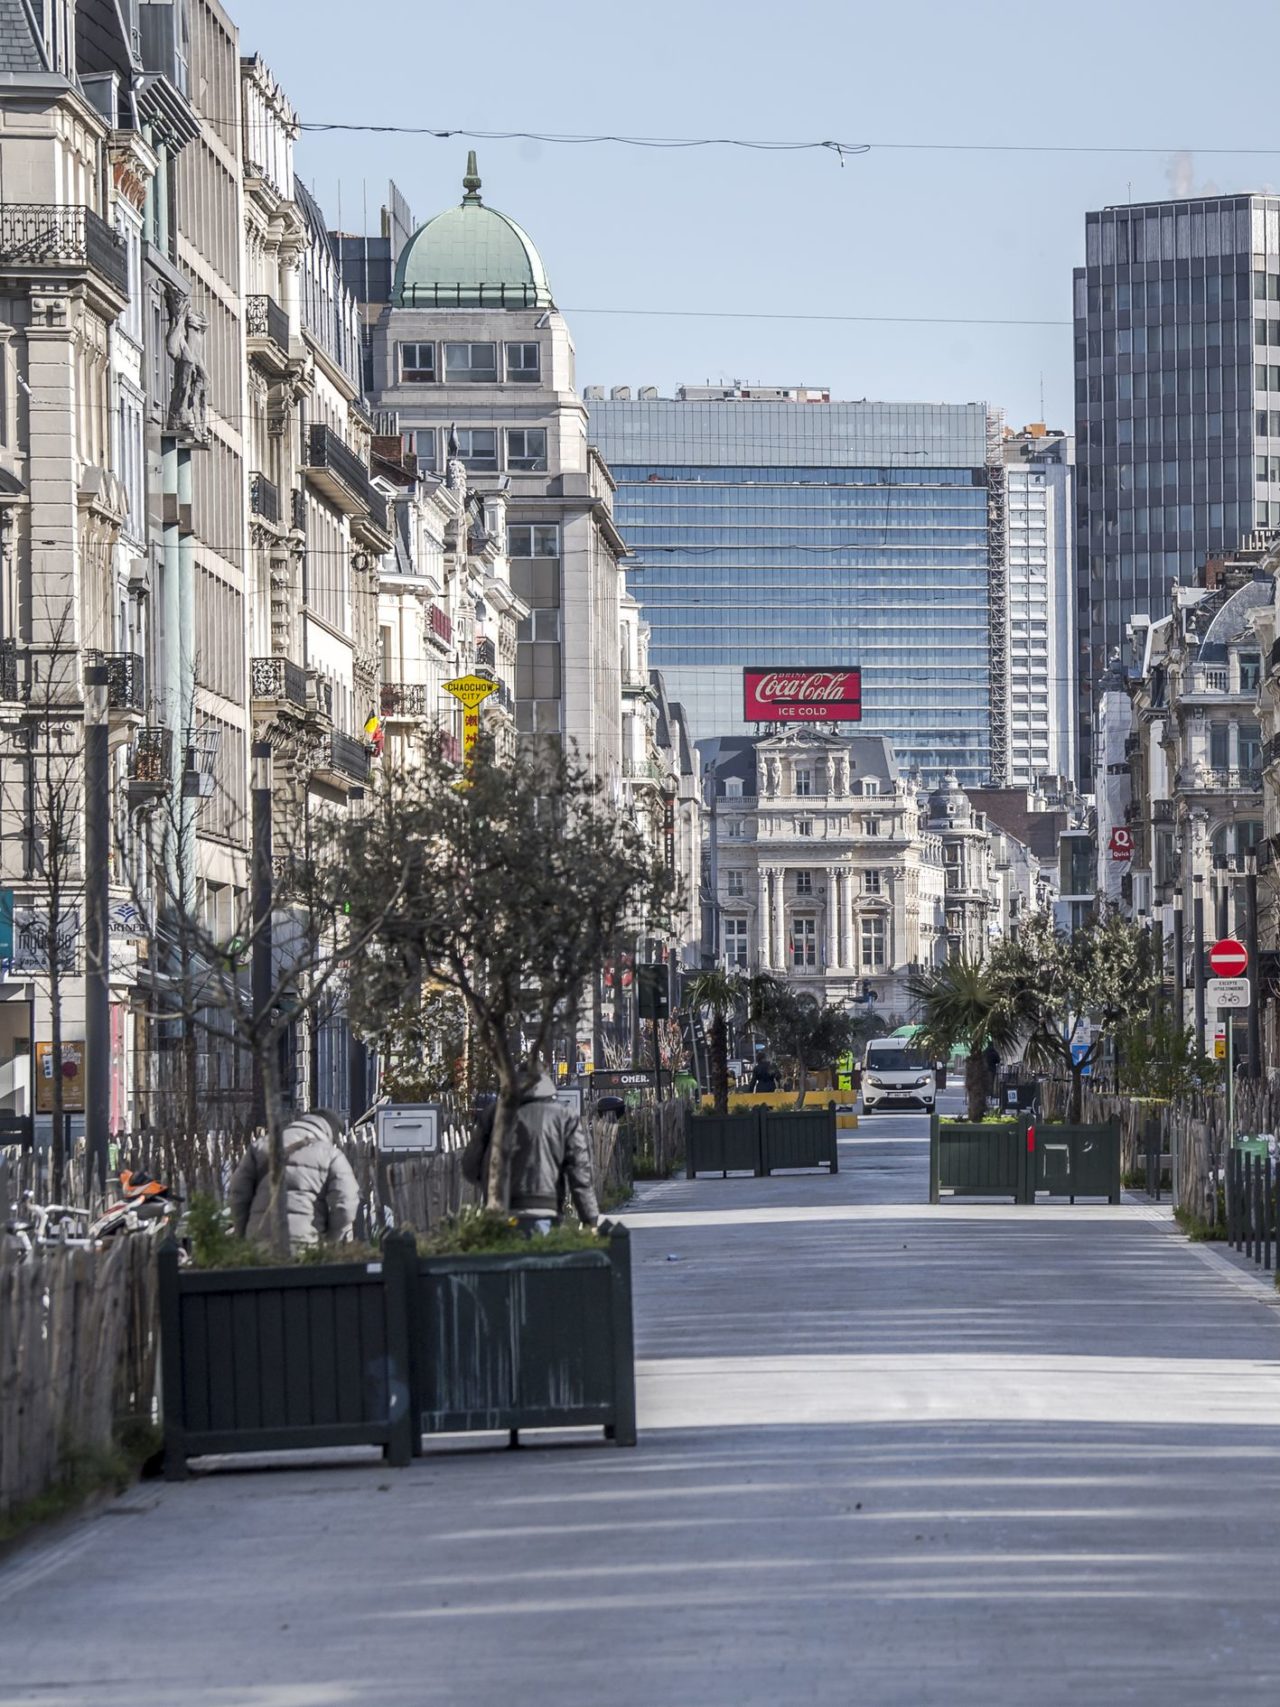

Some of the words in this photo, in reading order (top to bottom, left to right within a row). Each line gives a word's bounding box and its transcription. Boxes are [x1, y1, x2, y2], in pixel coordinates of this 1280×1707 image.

[447, 683, 494, 692] CHAOCHOW
[461, 692, 481, 701] CITY
[778, 707, 795, 716] ICE
[798, 707, 827, 716] COLD
[1114, 830, 1130, 847] Q
[1113, 850, 1130, 858] Quick
